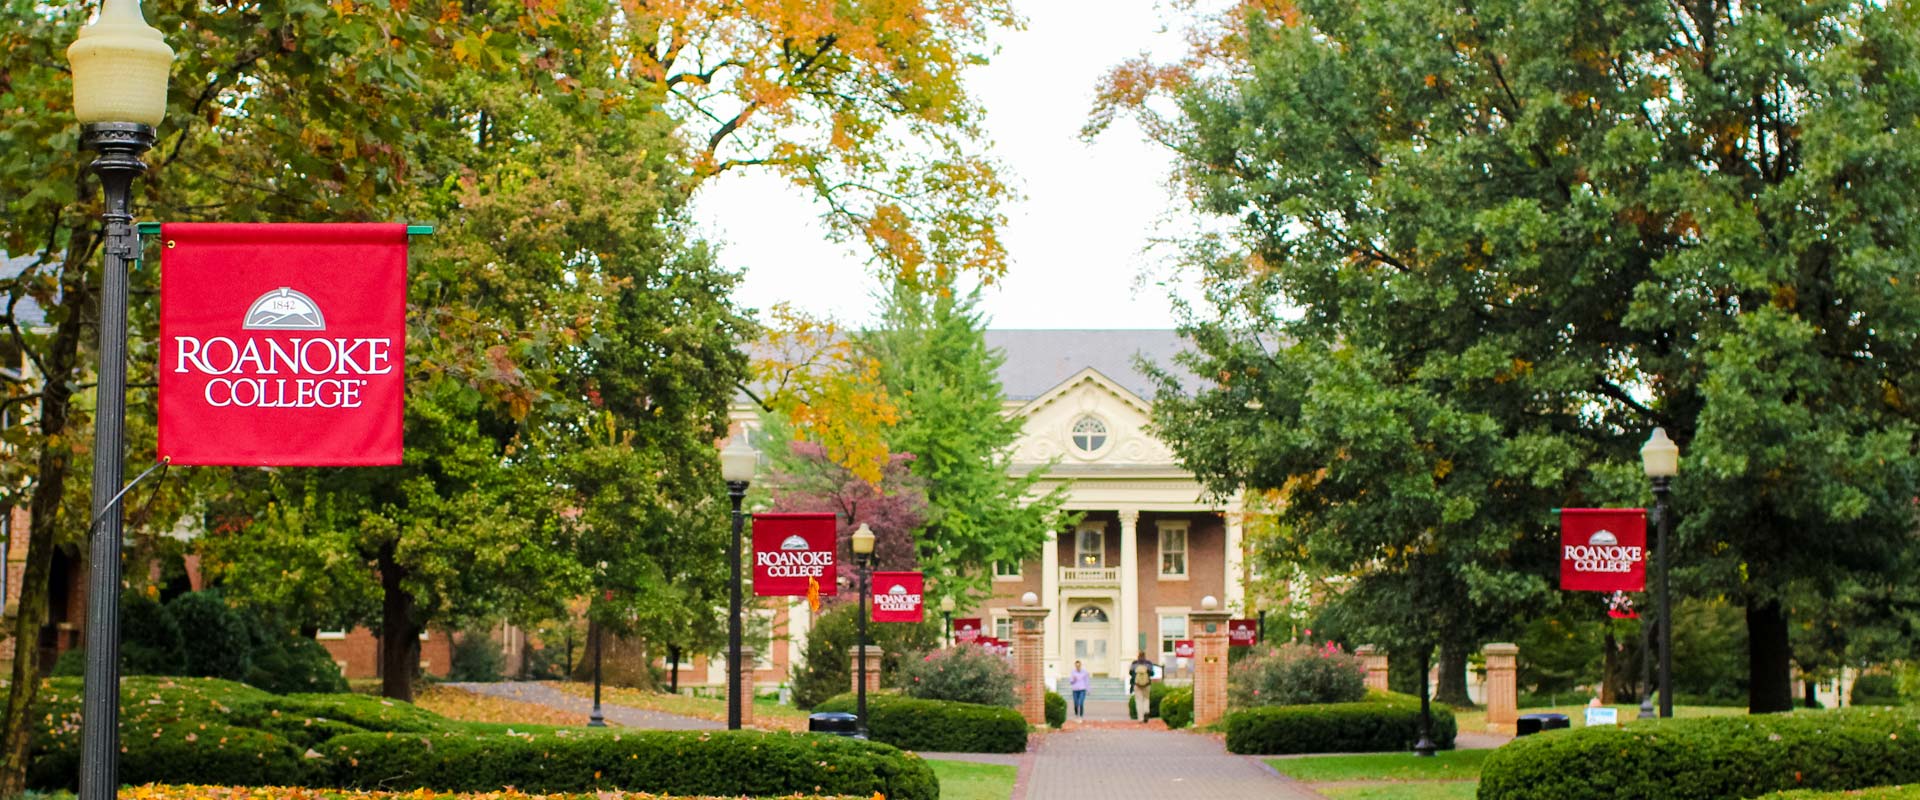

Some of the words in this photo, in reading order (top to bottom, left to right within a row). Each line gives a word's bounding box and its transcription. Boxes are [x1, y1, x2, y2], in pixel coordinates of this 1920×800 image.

[272, 300, 296, 311] 1842
[174, 336, 392, 375] ROANOKE
[205, 378, 363, 408] COLLEGE
[757, 551, 834, 566] ROANOKE
[1564, 545, 1642, 561] ROANOKE
[767, 565, 824, 578] COLLEGE
[1574, 560, 1632, 573] COLLEGE
[874, 594, 921, 605] ROANOKE
